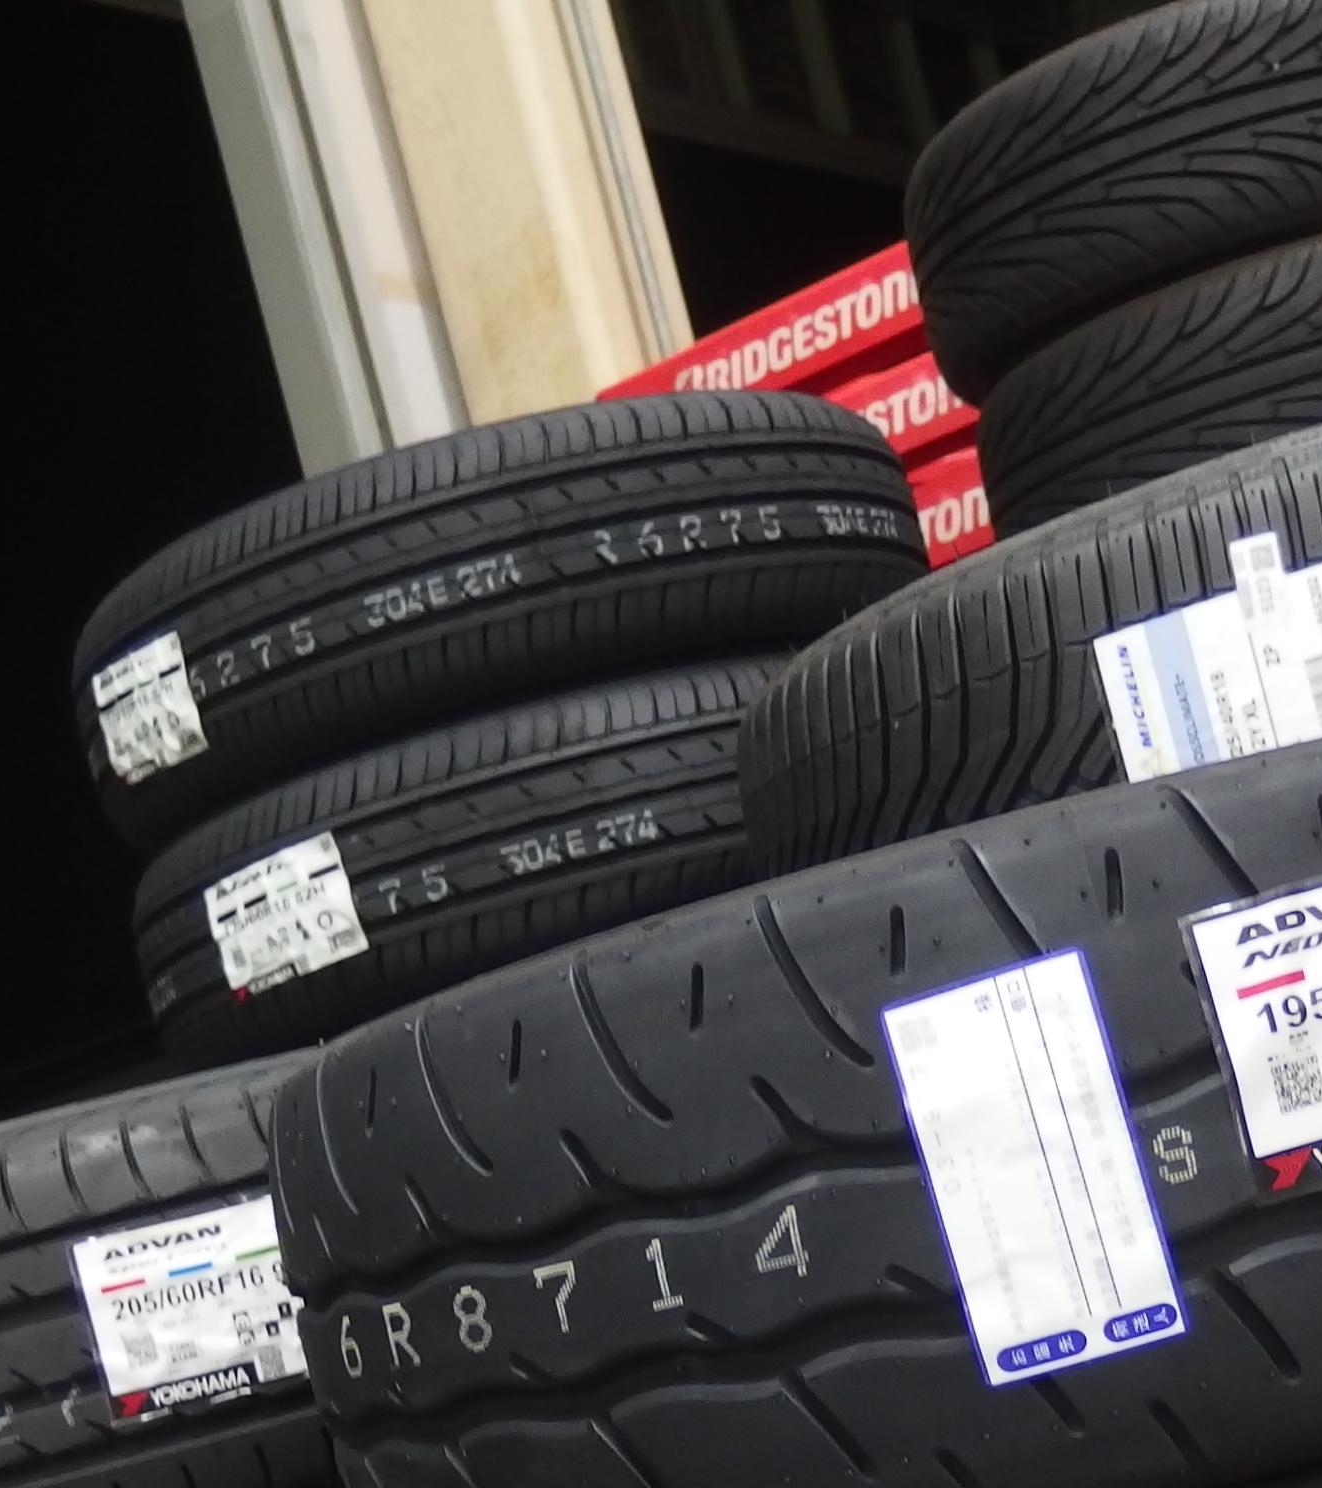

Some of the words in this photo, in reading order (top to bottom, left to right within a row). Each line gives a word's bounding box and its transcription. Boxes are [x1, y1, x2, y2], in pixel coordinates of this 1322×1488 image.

[1116, 644, 1154, 750] MICHELIN
[103, 1224, 222, 1262] ADVAN
[151, 1369, 251, 1408] YOKOHAMA
